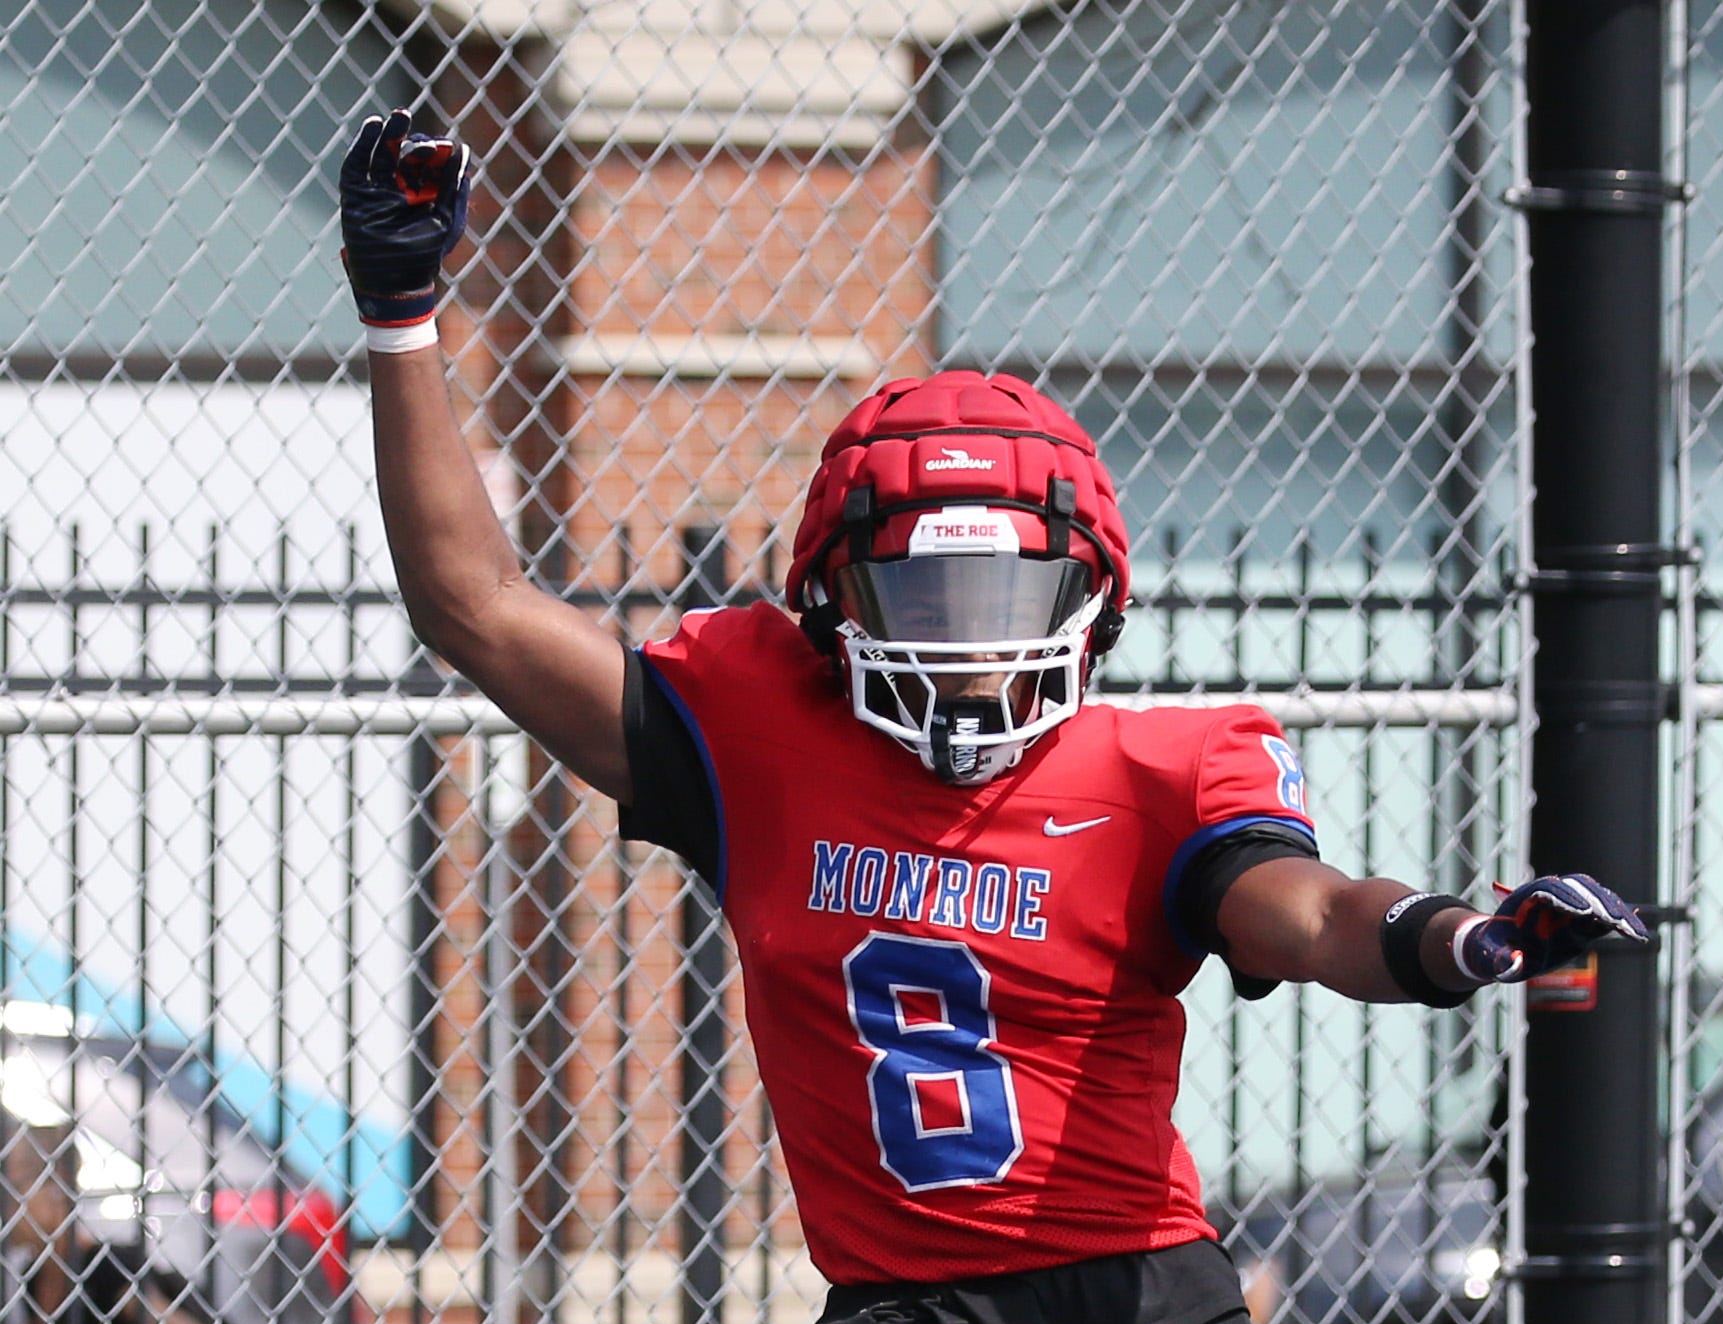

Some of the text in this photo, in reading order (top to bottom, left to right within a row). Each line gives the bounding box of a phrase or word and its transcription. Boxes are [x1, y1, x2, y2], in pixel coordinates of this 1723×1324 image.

[925, 458, 993, 471] GUARDIAN
[934, 524, 965, 537] THE
[968, 524, 998, 537] ROE
[1261, 733, 1306, 817] 8
[807, 840, 1051, 942] MONROE
[842, 930, 1024, 1193] 8
